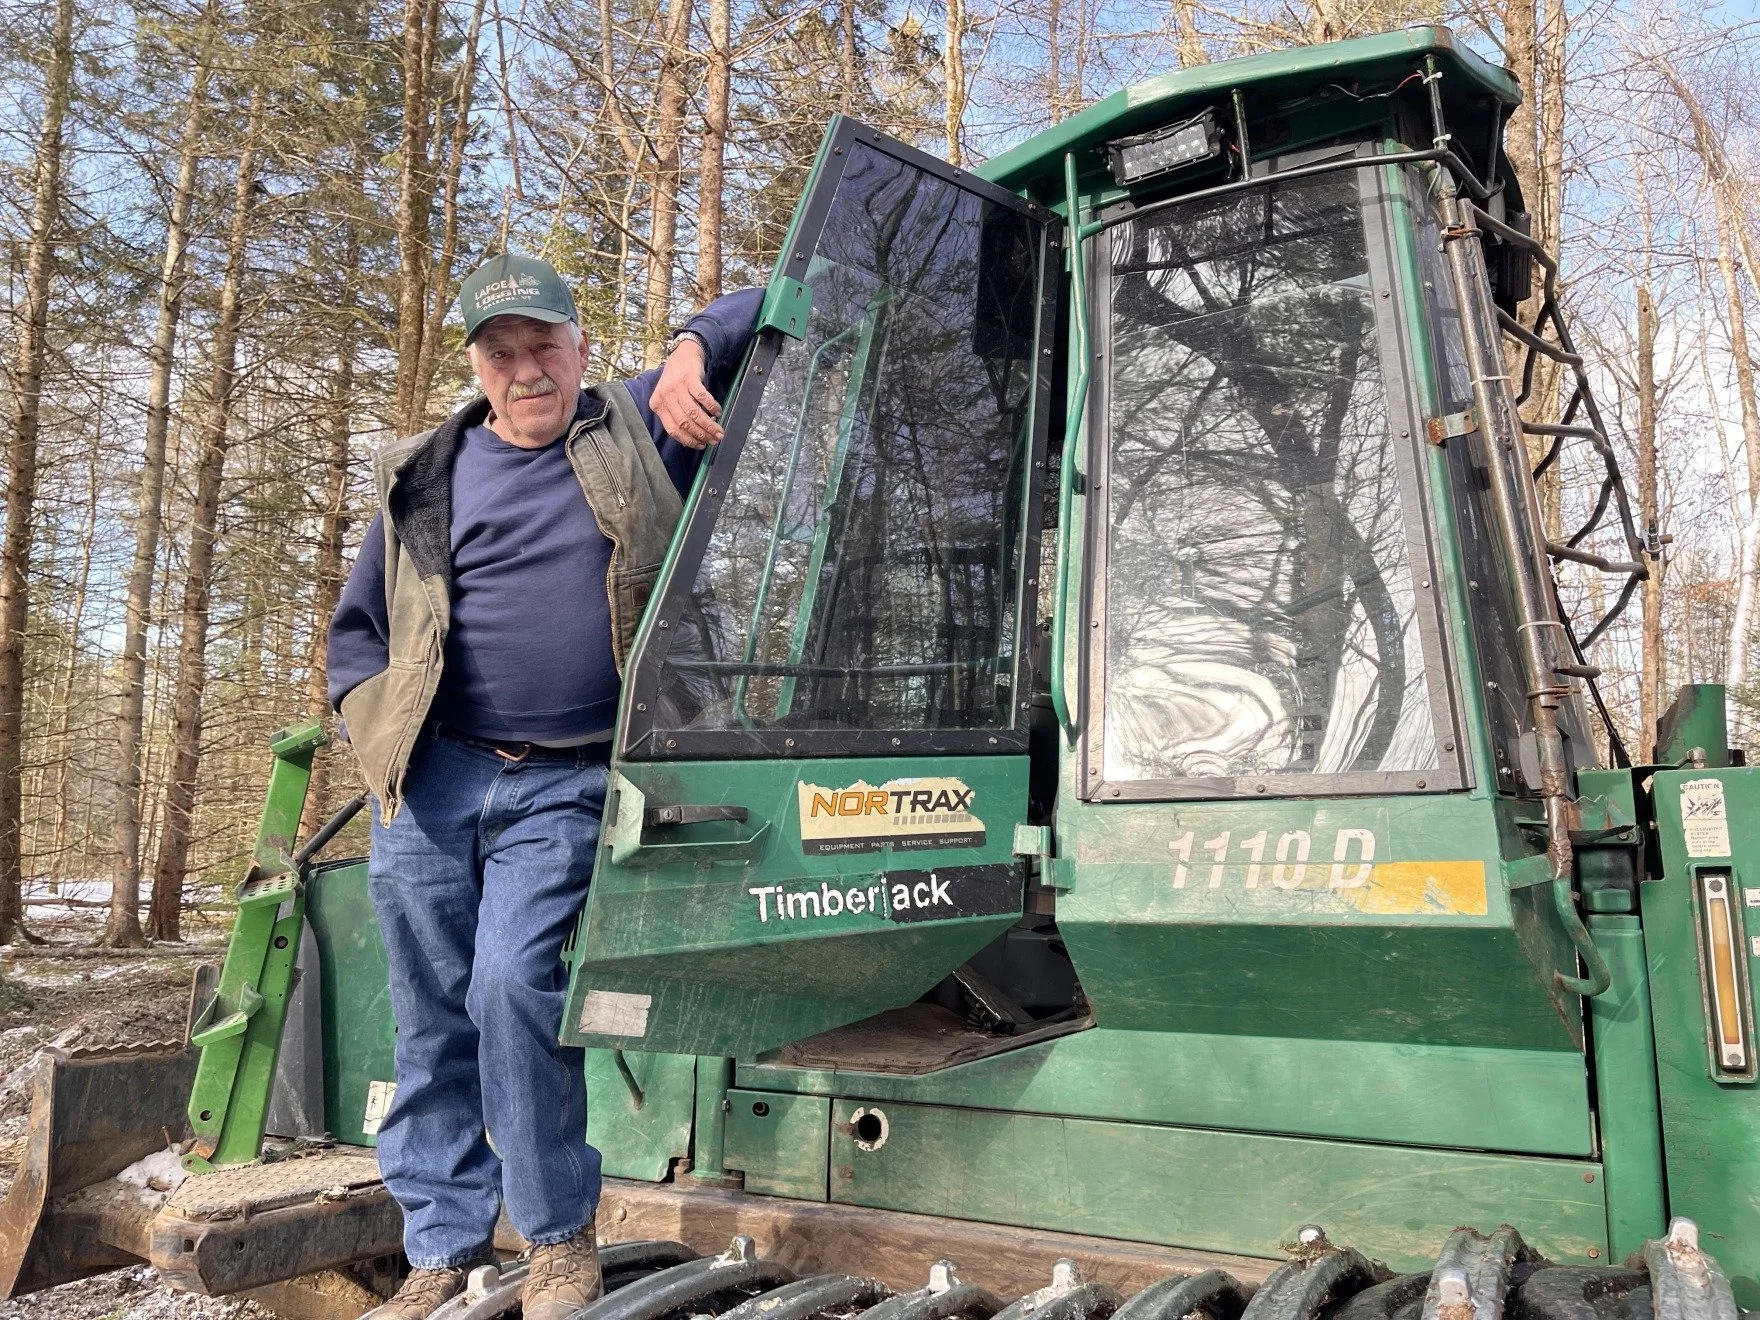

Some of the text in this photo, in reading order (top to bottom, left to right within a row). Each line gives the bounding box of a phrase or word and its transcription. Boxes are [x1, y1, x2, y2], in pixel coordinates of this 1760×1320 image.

[475, 280, 508, 300] LAFOE
[476, 288, 540, 309] LOGGING
[810, 789, 972, 818] NORTRAX
[819, 842, 864, 851] EQUIPMENT
[901, 839, 933, 847] SERVICE
[939, 837, 972, 845] SUPPORT
[1168, 828, 1377, 890] 1110 D
[748, 873, 954, 923] Timberjack
